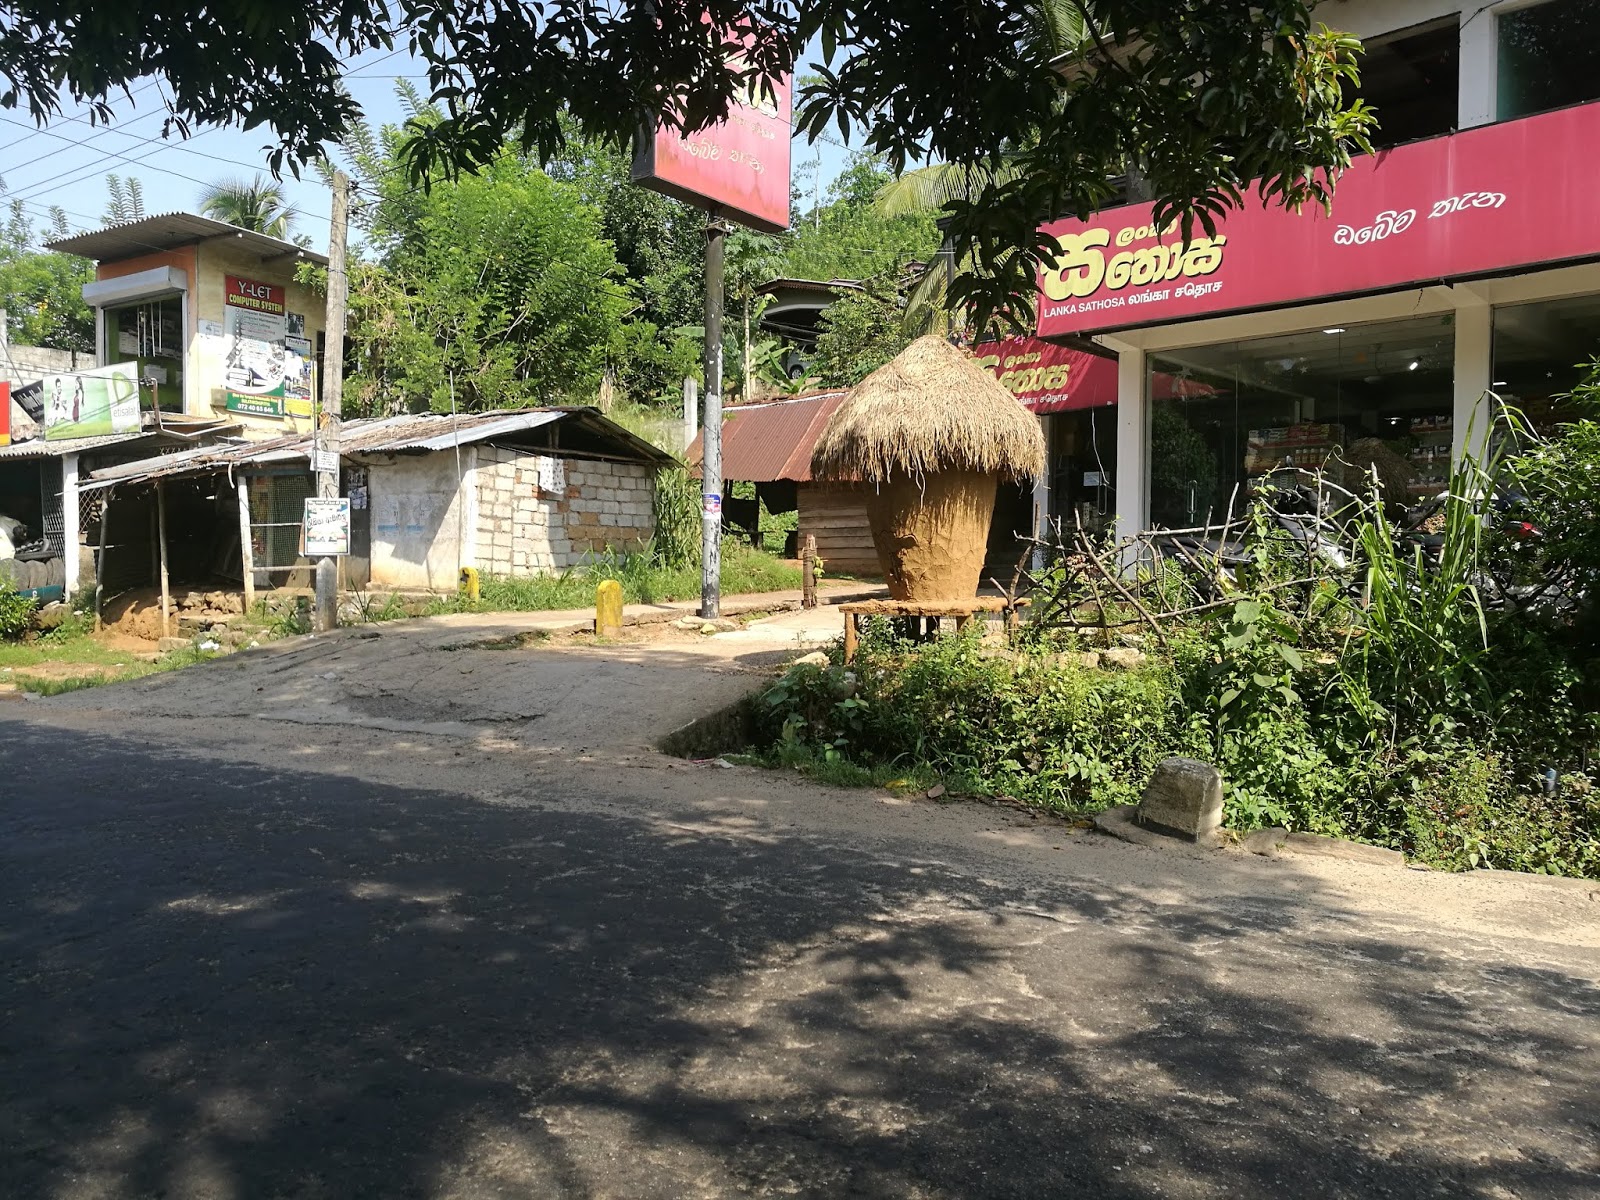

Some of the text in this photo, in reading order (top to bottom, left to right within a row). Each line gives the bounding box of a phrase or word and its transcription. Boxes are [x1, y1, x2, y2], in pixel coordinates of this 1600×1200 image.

[1333, 191, 1507, 245] ඔබේම තැන
[238, 281, 272, 299] Y-LET
[1128, 281, 1223, 305] லங்கா சதொச
[229, 293, 283, 312] COMPUTER SYSTEM
[1044, 297, 1126, 318] LANKA SATHOSA
[113, 405, 137, 418] etisalat
[237, 403, 248, 411] 072
